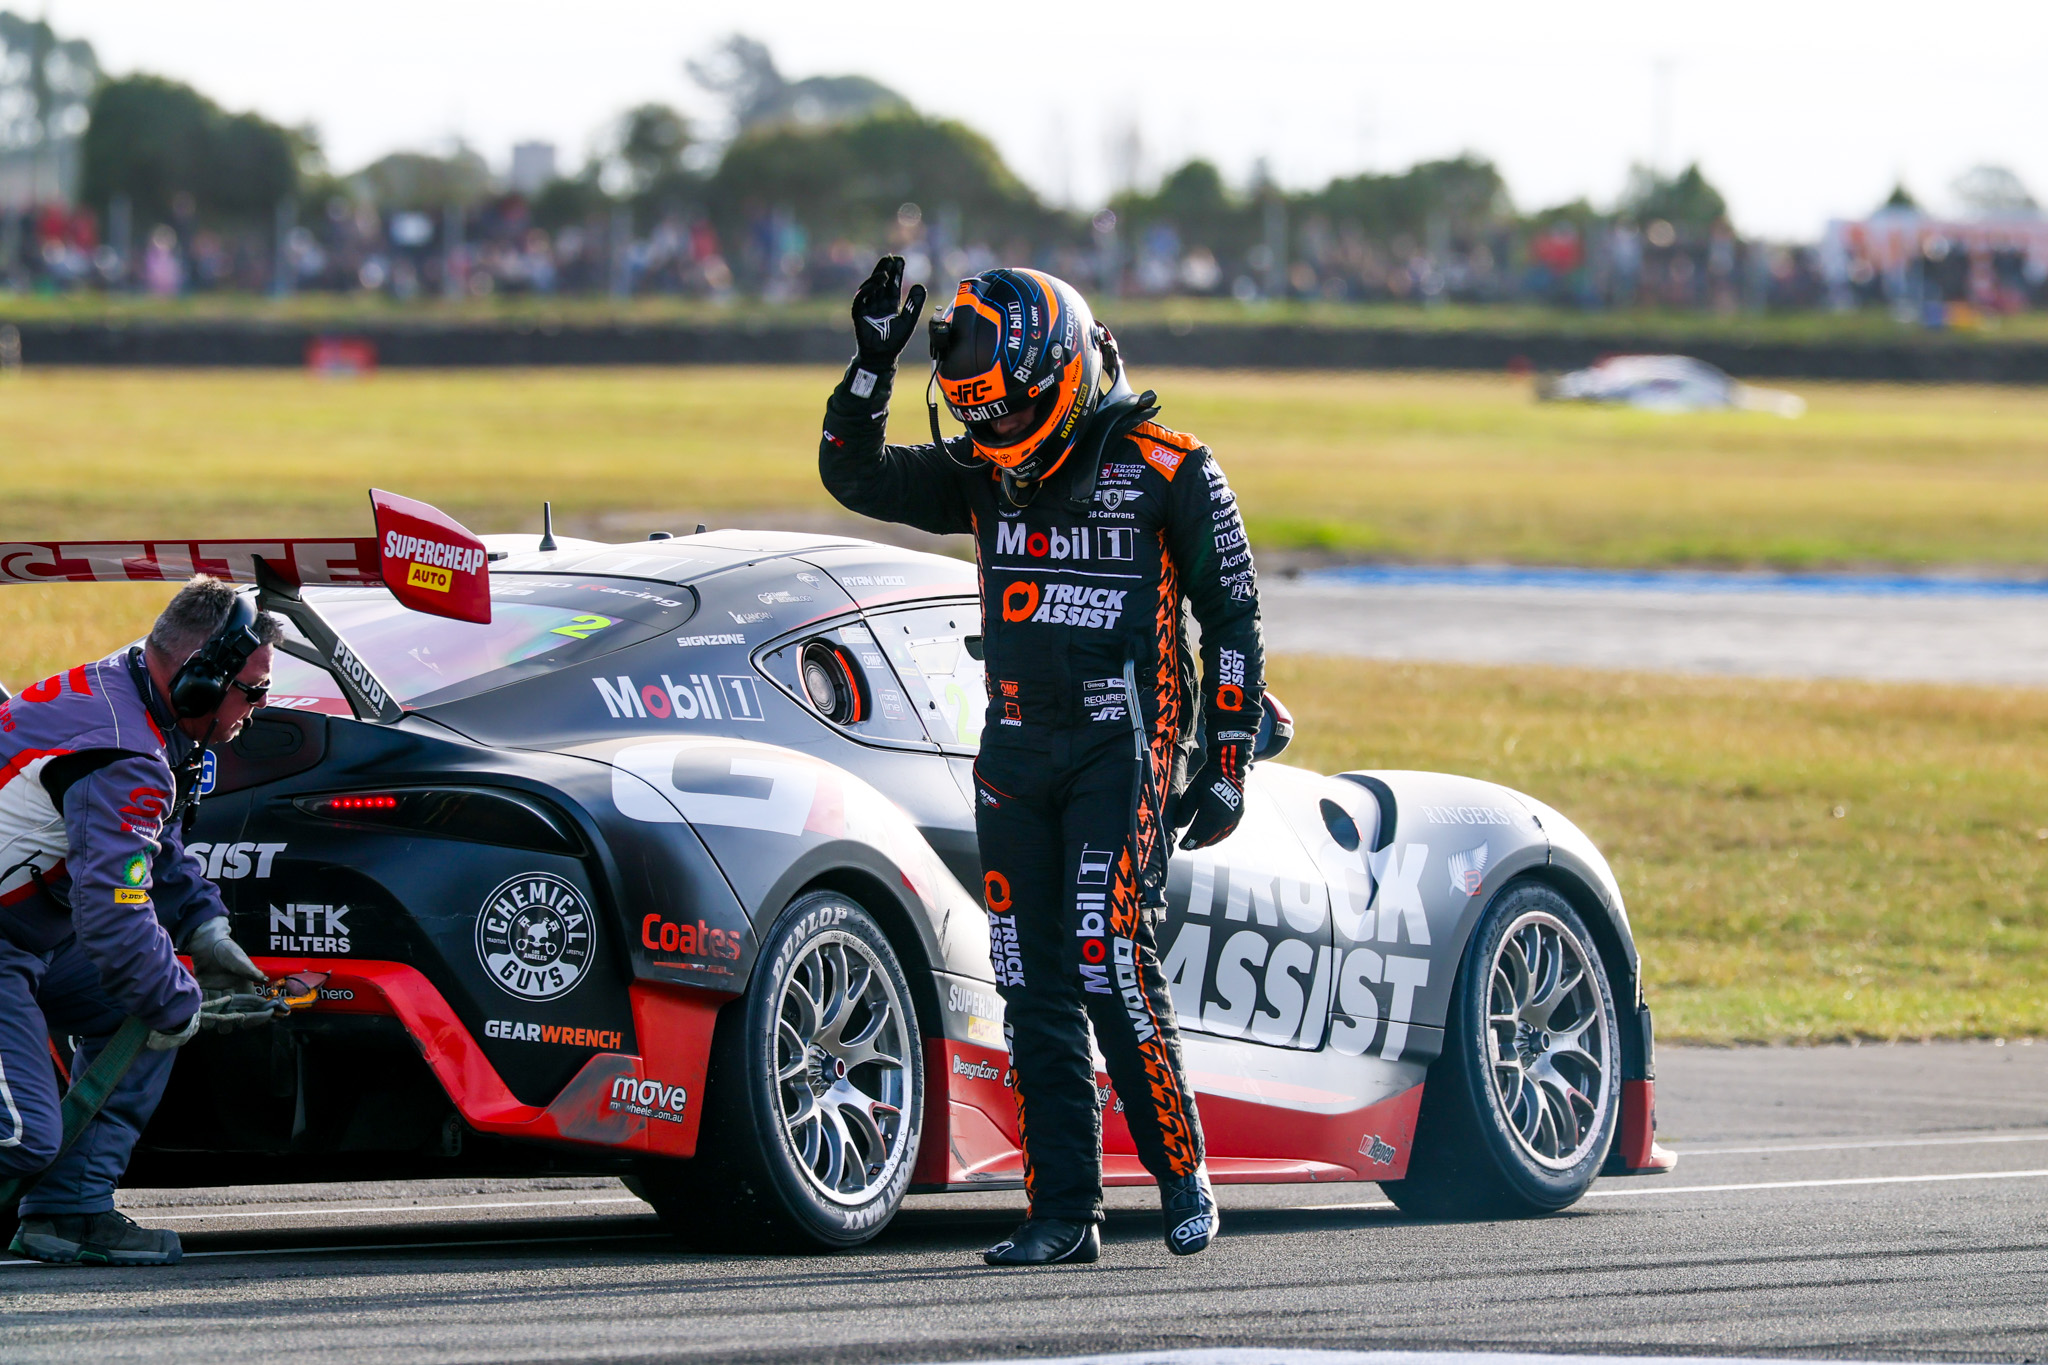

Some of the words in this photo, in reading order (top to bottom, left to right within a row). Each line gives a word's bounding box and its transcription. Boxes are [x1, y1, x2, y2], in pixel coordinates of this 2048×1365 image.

[1008, 315, 1022, 350] Mobil
[952, 405, 990, 422] Mobil
[1060, 405, 1082, 439] DAYLE
[1151, 449, 1179, 468] OMP
[1098, 511, 1135, 519] Caravans
[384, 530, 485, 576] SUPERCHEAP
[996, 521, 1090, 560] Mobil
[412, 568, 448, 587] AUTO
[841, 576, 873, 587] RYAN
[875, 575, 907, 587] WOOD
[577, 583, 683, 609] Racing
[1043, 584, 1128, 610] TRUCK
[550, 614, 612, 640] 2
[1031, 604, 1122, 630] ASSIST
[676, 633, 746, 648] SIGNZONE
[334, 639, 387, 711] PROUDI
[863, 655, 881, 666] OMP
[592, 674, 723, 720] Mobil
[1000, 683, 1019, 696] OMP
[1084, 693, 1127, 704] REQUIRED
[1000, 719, 1022, 727] WOOD
[1213, 781, 1241, 808] OMP
[1420, 806, 1511, 825] RINGERS
[1187, 842, 1432, 946] TRUCK
[269, 903, 350, 936] NTK
[487, 882, 587, 944] CHEMICAL
[270, 935, 350, 953] FILTERS
[642, 913, 741, 960] Coates
[773, 906, 848, 988] DUNLOP
[830, 931, 841, 942] PRO
[843, 934, 856, 947] RACE
[859, 944, 880, 970] FORGED
[987, 910, 1009, 987] ASSIST
[1000, 915, 1026, 987] TRUCK
[1076, 893, 1112, 995] Mobil
[523, 953, 548, 961] ANGELES
[500, 959, 564, 992] GUYS
[1114, 936, 1156, 1043] WOOD
[1161, 921, 1431, 1062] ASSIST
[485, 1019, 622, 1049] GEARWRENCH
[971, 1022, 999, 1040] AUTO
[953, 1054, 999, 1081] DesignEars
[612, 1077, 687, 1112] move
[876, 1130, 907, 1192] SUPERCARS
[1367, 1134, 1396, 1166] Repco
[887, 1127, 919, 1210] SPORT
[842, 1200, 888, 1230] MAXX
